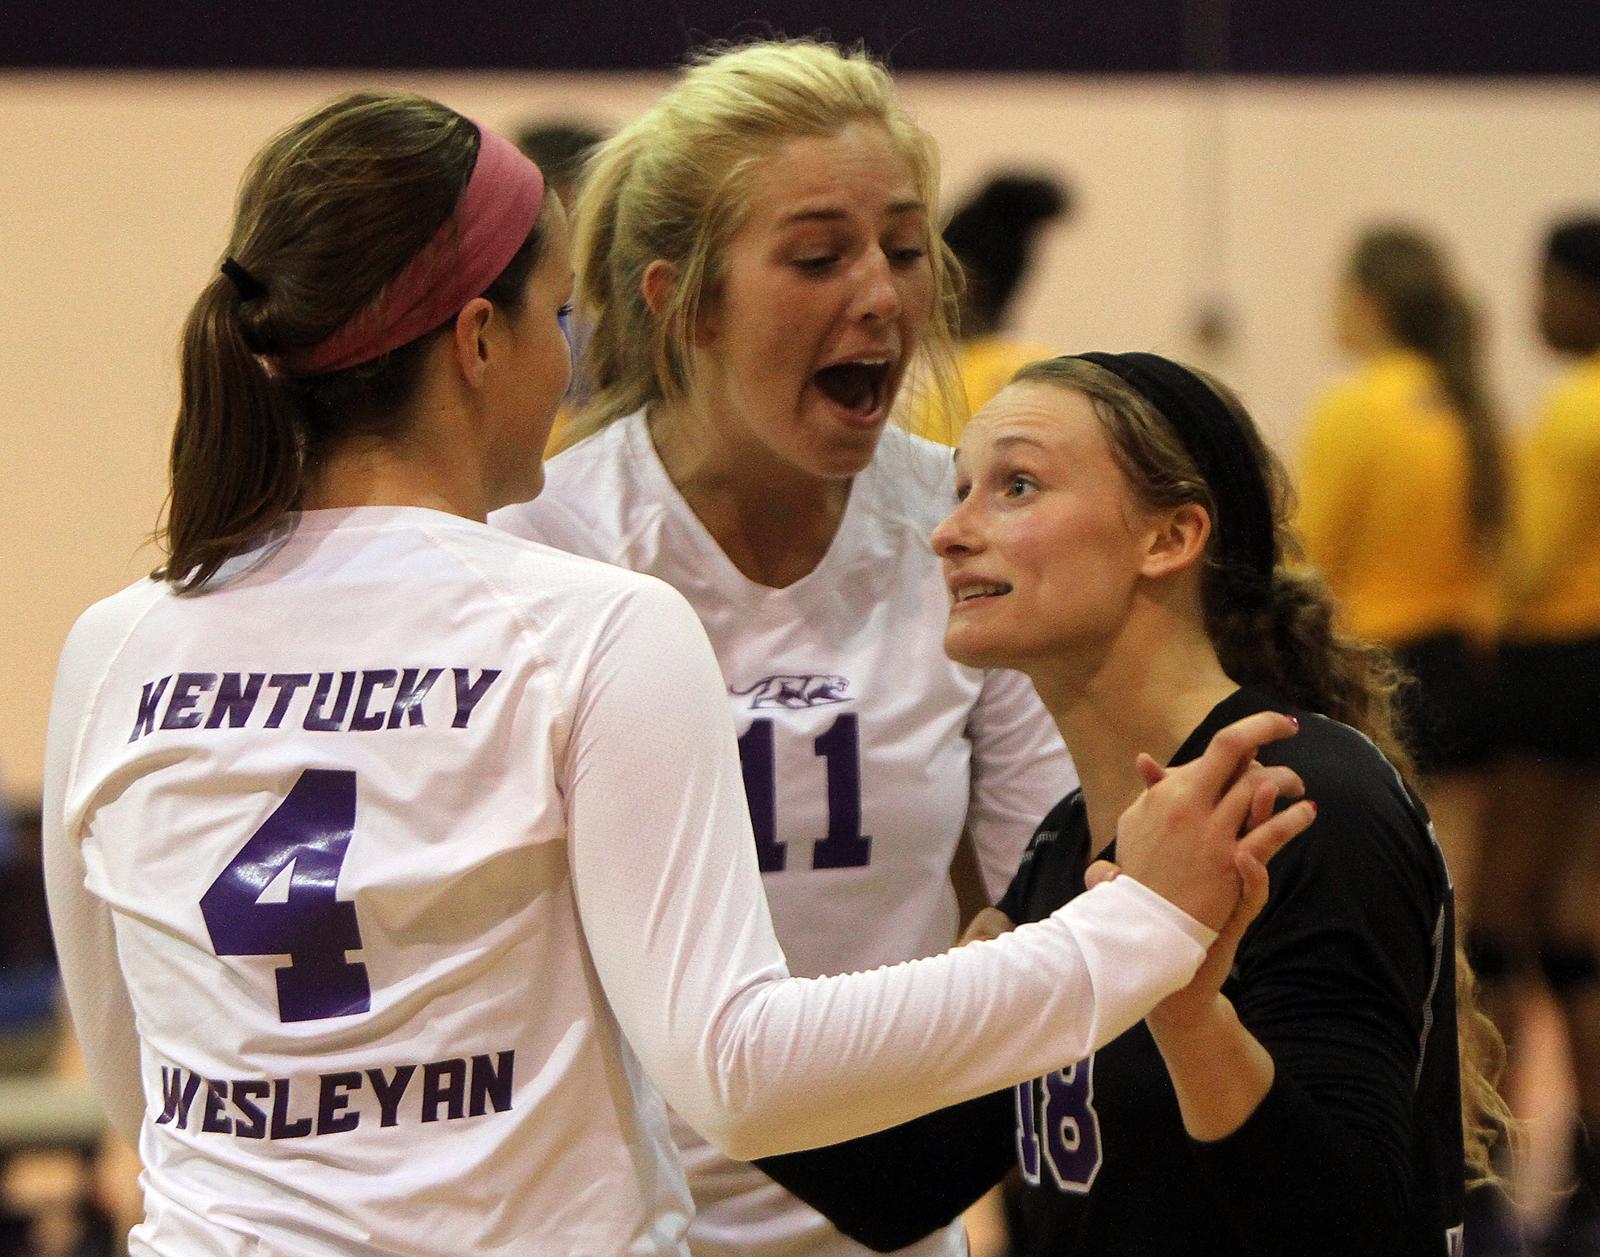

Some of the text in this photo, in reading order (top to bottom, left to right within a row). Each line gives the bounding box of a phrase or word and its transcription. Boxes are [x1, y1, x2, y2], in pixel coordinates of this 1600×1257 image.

[128, 668, 503, 744] KENTUCKY
[738, 712, 873, 873] 11
[199, 768, 371, 1023] 4
[155, 1050, 515, 1140] WESLEYAN
